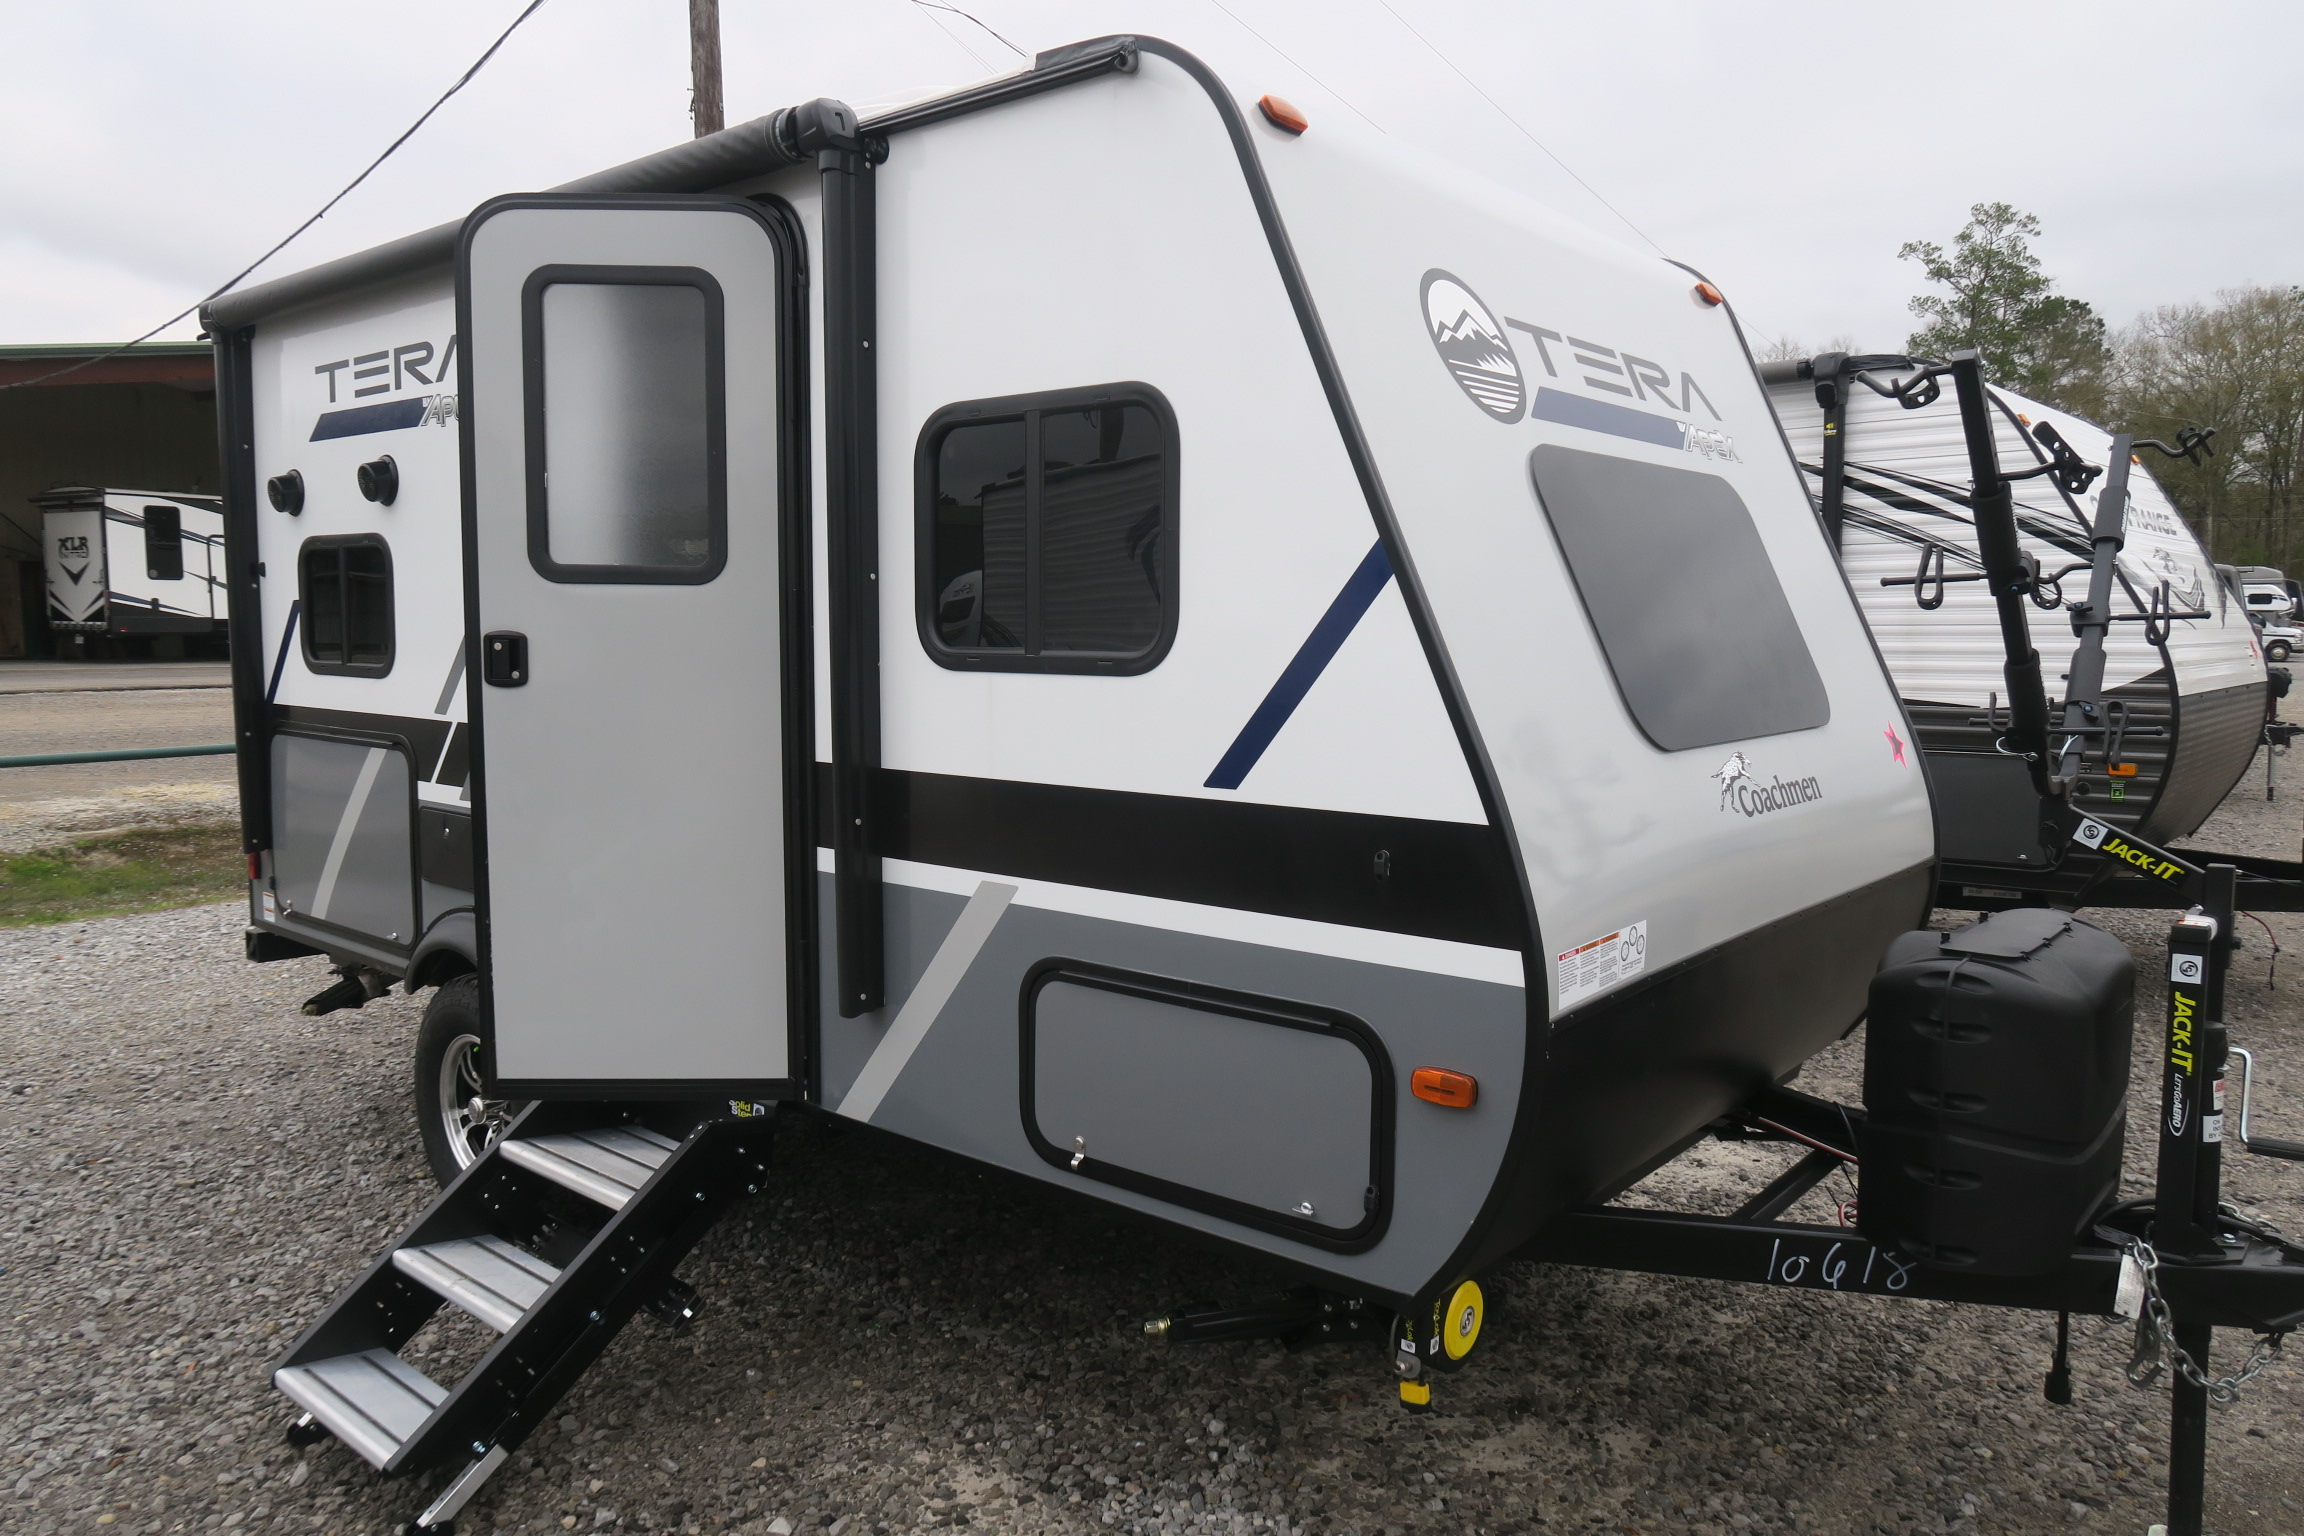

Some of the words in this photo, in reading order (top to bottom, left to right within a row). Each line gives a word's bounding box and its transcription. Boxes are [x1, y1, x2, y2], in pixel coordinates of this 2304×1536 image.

[1503, 316, 1723, 421] TERA
[1737, 775, 1823, 818] Coachmen
[2101, 837, 2183, 880] JACK-IT
[2171, 991, 2196, 1073] JACK-IT
[1767, 1238, 1917, 1290] 10618
